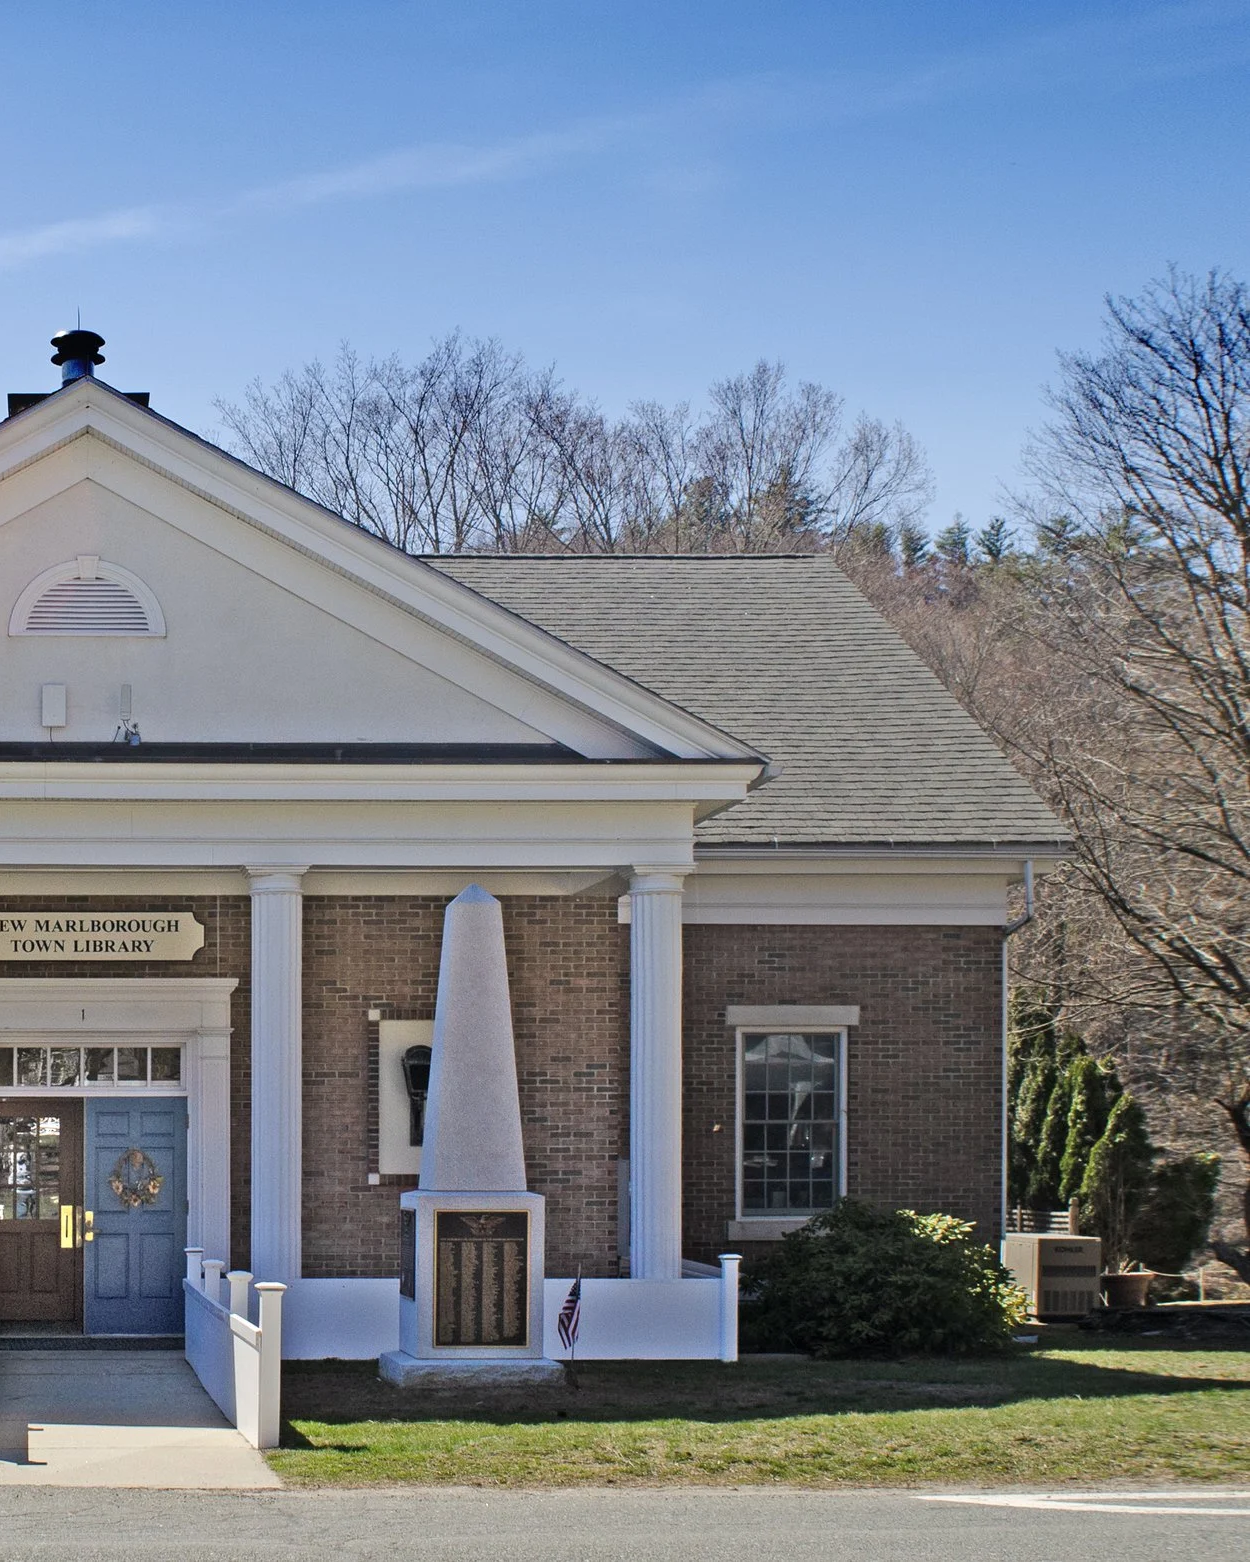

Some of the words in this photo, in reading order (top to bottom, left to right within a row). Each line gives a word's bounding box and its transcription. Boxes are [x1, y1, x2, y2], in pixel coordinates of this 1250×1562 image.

[34, 919, 180, 933] MARLBOROUGH
[10, 939, 65, 953] TOWN
[73, 939, 155, 953] LIBRARY
